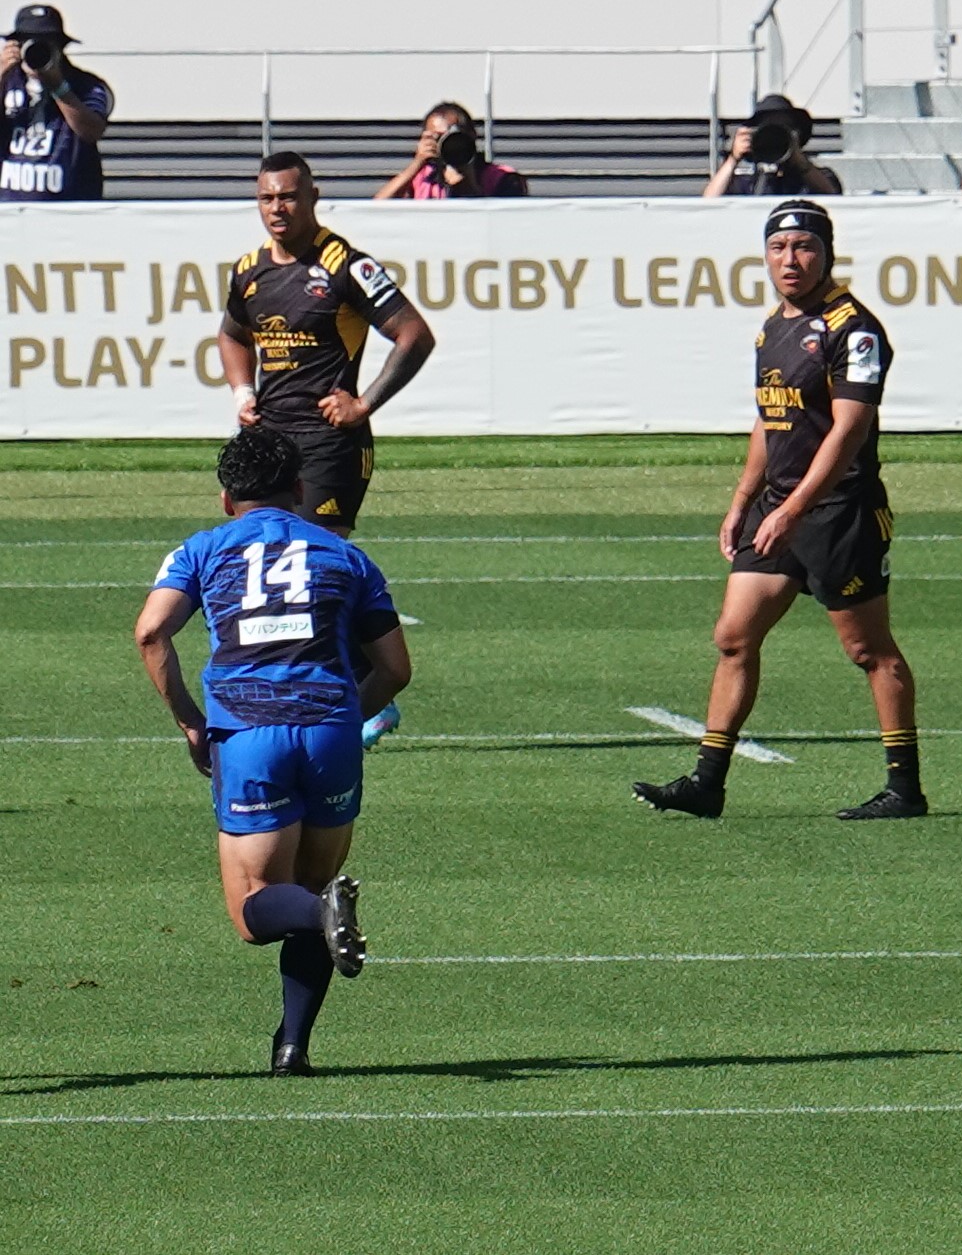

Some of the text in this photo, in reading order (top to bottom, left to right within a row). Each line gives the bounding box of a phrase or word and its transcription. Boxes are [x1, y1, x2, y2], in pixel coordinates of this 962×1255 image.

[5, 262, 125, 313] NTT
[613, 256, 853, 307] LEAG
[241, 540, 312, 610] 14
